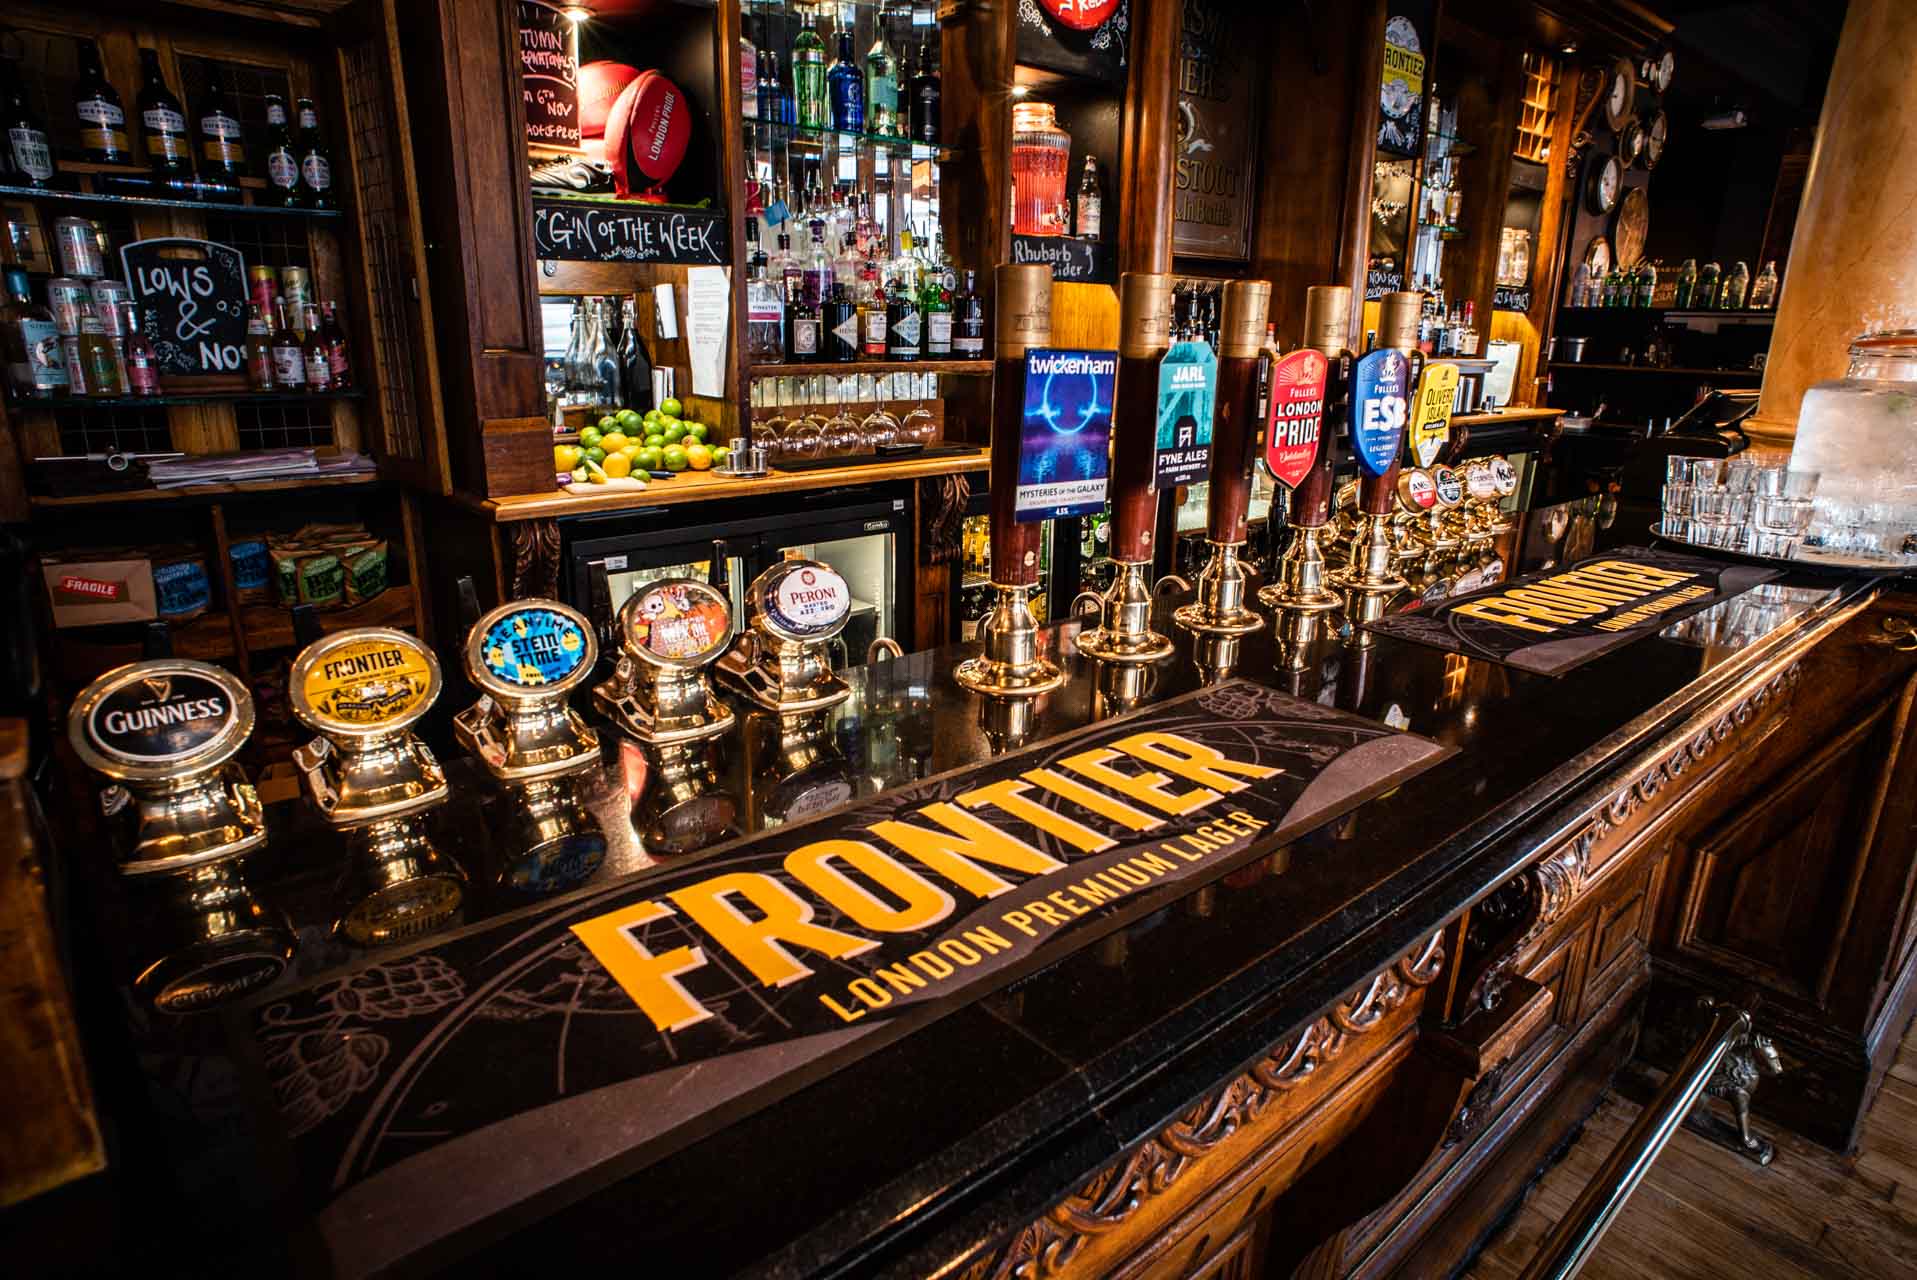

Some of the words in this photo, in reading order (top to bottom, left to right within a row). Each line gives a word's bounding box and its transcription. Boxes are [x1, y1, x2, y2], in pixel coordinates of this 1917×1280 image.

[648, 117, 670, 161] LONDON
[661, 89, 675, 121] PRIDE
[550, 210, 600, 253] GIN
[598, 221, 616, 247] OF
[617, 216, 654, 252] THE
[660, 213, 723, 263] WEEK
[1014, 239, 1072, 264] Rhubarb
[137, 265, 214, 302] LOWS
[175, 299, 217, 341] &
[1029, 354, 1115, 376] twickenham
[1172, 365, 1206, 383] JARL
[1277, 400, 1323, 417] LONDON
[1362, 395, 1407, 432] ESB
[1273, 416, 1322, 448] PRIDE
[1158, 452, 1185, 466] FYNE
[1184, 449, 1209, 463] ALES
[1019, 488, 1058, 500] MYSTERIES
[1077, 484, 1105, 495] GALAXY
[65, 578, 117, 597] FRAGILE
[790, 587, 837, 605] PERONI
[1449, 559, 1701, 633] FRONTIER
[511, 634, 560, 655] STEIN
[517, 648, 562, 670] TIME
[323, 650, 406, 682] FRONTIER
[104, 697, 224, 735] GUINNESS
[567, 731, 1288, 1034] FRONTIER
[818, 925, 1014, 1025] LONDON
[1001, 851, 1180, 938] PREMIUM
[1160, 810, 1270, 863] LAGER
